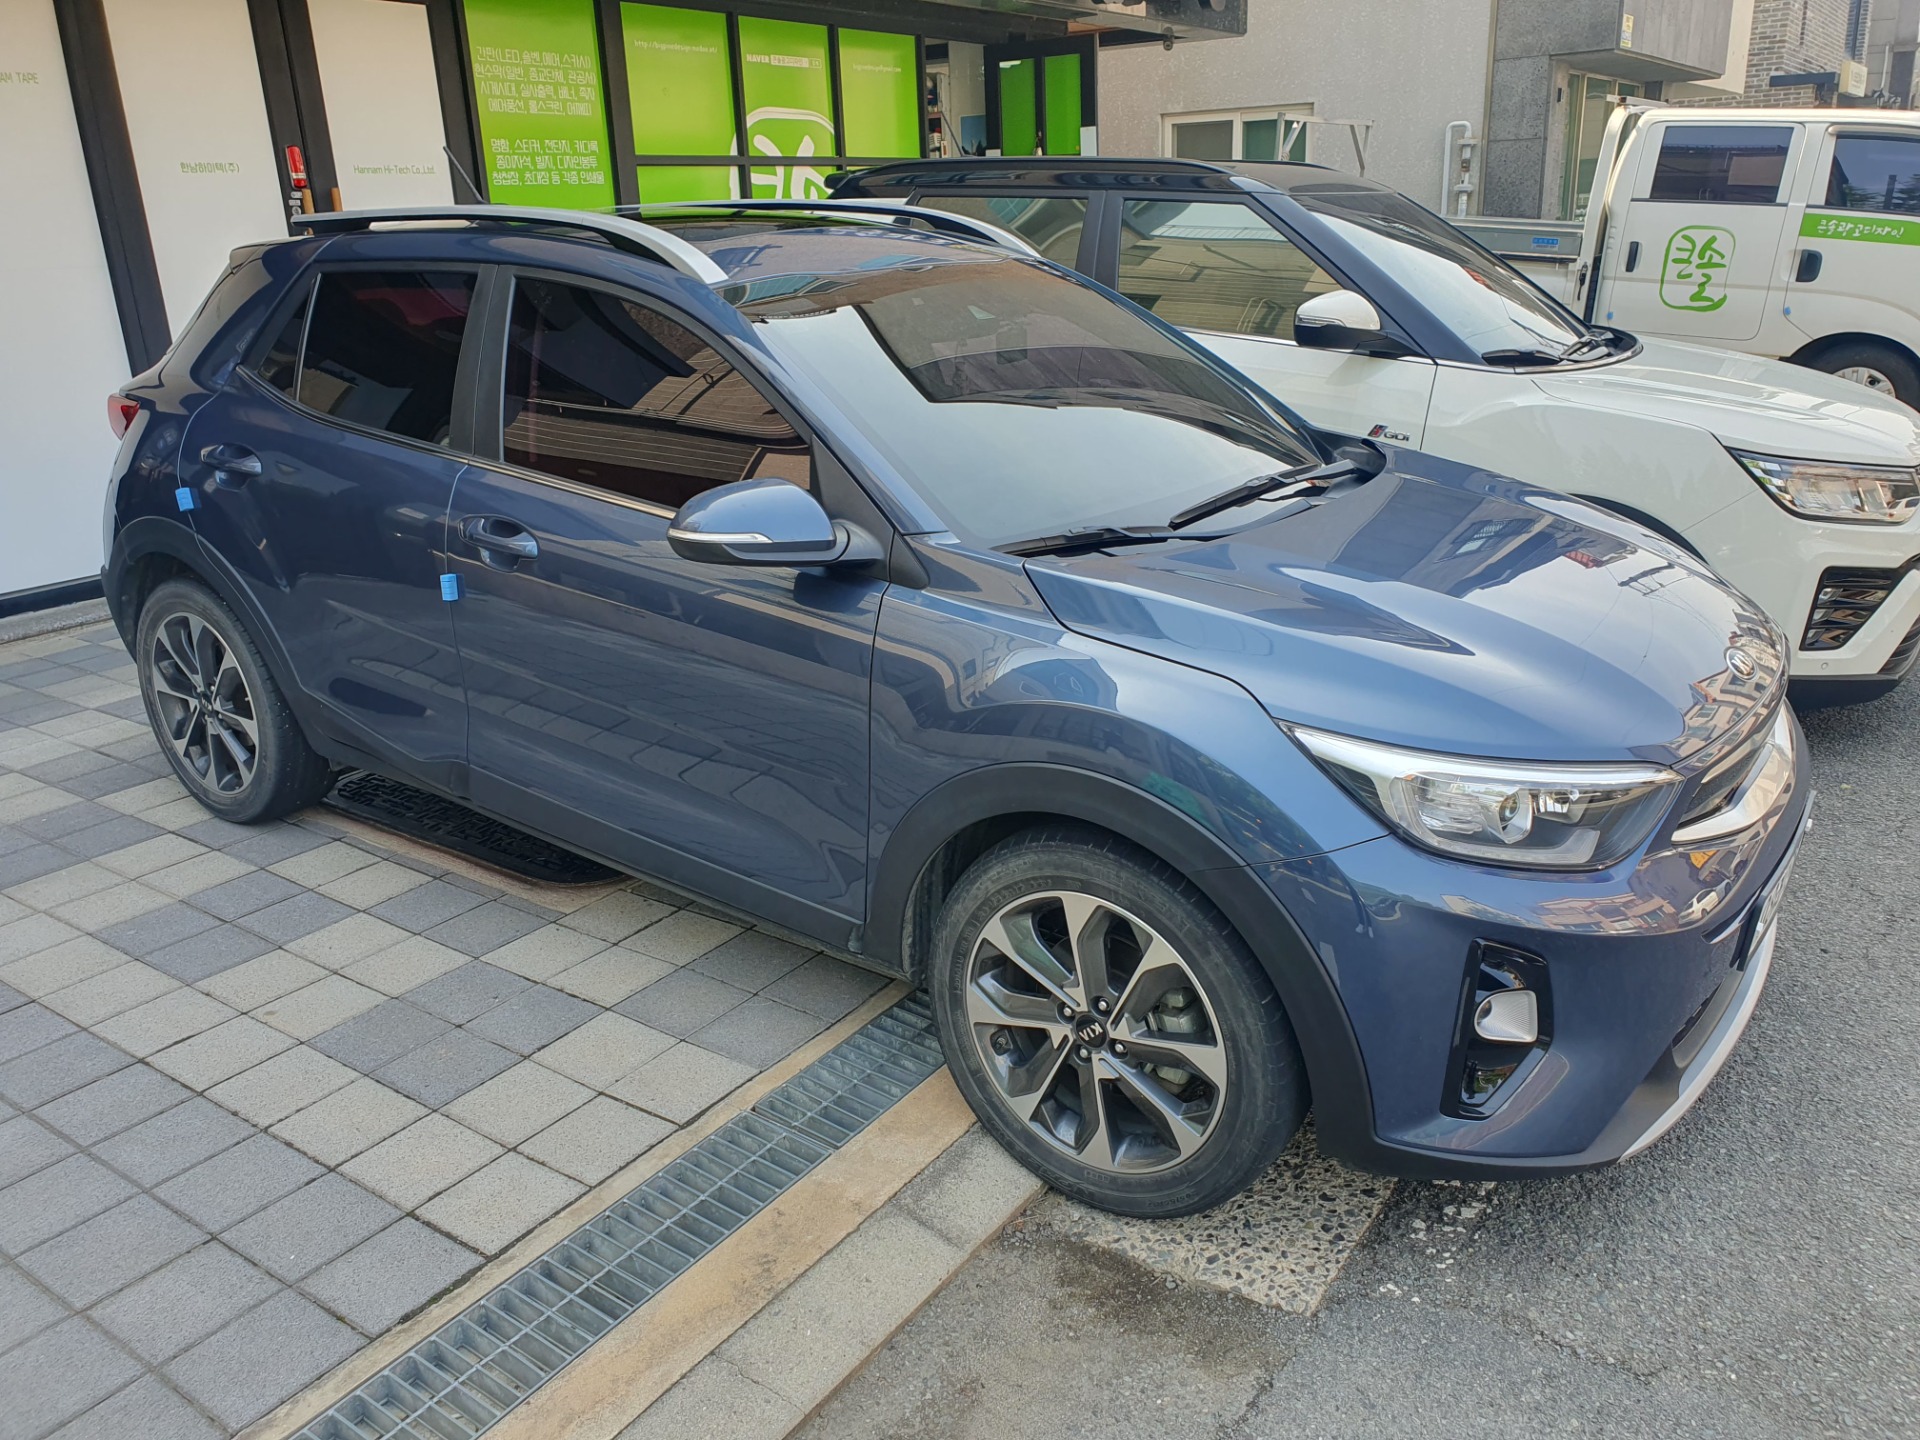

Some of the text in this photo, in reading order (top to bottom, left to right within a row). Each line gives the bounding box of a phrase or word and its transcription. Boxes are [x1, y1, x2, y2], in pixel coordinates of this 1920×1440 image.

[746, 54, 769, 63] NAVER
[15, 71, 39, 84] TAPE
[475, 63, 596, 85] 현수막(일반, 종교단체, 관공서)
[520, 83, 557, 99] 실사출력,
[558, 86, 577, 100] 배너,
[579, 86, 595, 100] 족자
[488, 98, 527, 114] 에어풍선,
[491, 138, 512, 153] 명함,
[515, 139, 543, 154] 스티커,
[544, 139, 572, 154] 전단지,
[179, 161, 240, 174] 한남하이텍(주)
[353, 164, 383, 174] Hannam
[383, 164, 411, 175] Hi-Tech
[496, 155, 598, 170] 종이자석, 빌지, 디자인봉투
[492, 171, 605, 186] 청첩장, 초대장 등 각종 인쇄물
[1817, 219, 1905, 238] 큰솔광고디자인
[1671, 234, 1727, 303] 큰솔
[1078, 1022, 1104, 1041] KIA
